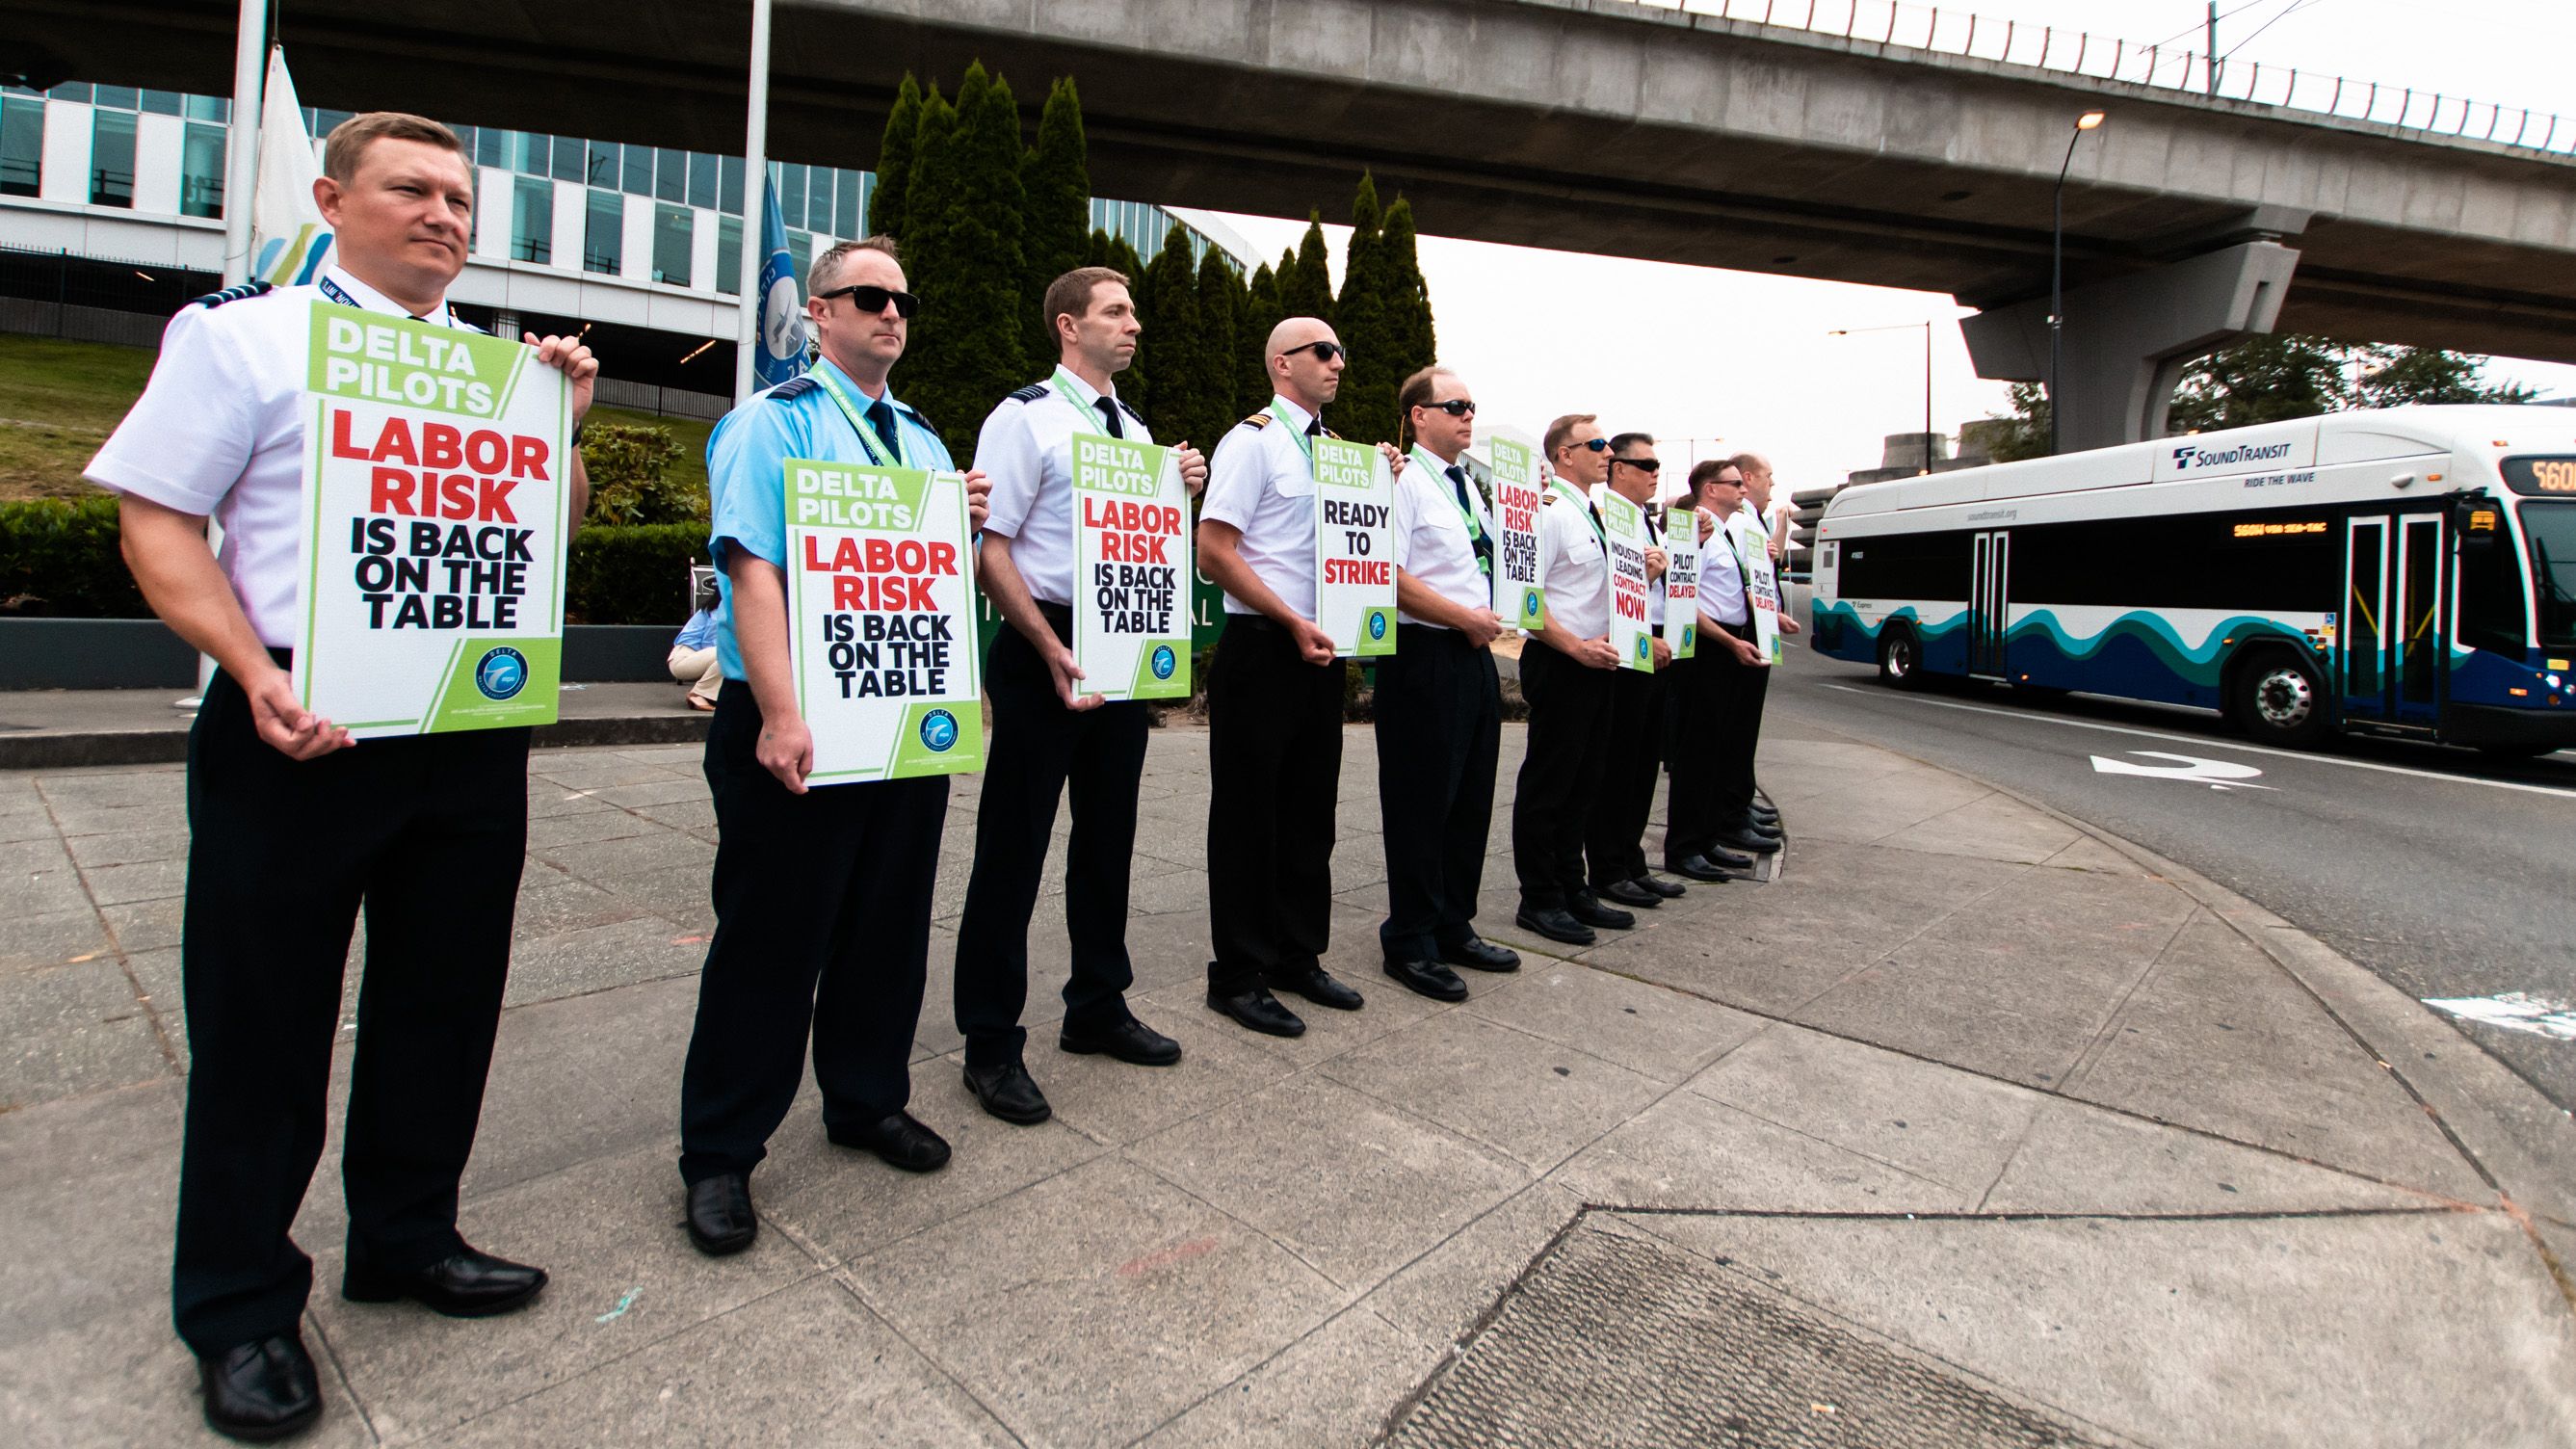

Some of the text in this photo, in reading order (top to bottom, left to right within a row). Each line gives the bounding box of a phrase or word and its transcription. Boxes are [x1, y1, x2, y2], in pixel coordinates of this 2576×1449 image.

[328, 317, 477, 377] DELTA
[326, 357, 493, 414] PILOTS
[332, 408, 550, 482] LABOR
[1080, 440, 1145, 471] DELTA
[1318, 443, 1363, 467] DELTA
[1494, 442, 1523, 465] DELTA
[797, 469, 899, 501] DELTA
[1081, 467, 1154, 495] PILOTS
[1319, 463, 1370, 487] PILOTS
[1495, 461, 1527, 484] PILOTS
[2244, 472, 2315, 487] RIDE THE WAVE
[2532, 461, 2576, 491] 560
[370, 466, 518, 524] RISK
[1497, 483, 1539, 514] LABOR
[798, 498, 913, 529] PILOTS
[1085, 497, 1182, 537] LABOR
[1324, 499, 1390, 529] READY
[1505, 507, 1534, 534] RISK
[1607, 499, 1630, 521] DELTA
[1669, 512, 1688, 526] DELTA
[1967, 509, 2017, 521] soundtransit.org
[1607, 514, 1635, 538] PILOTS
[1669, 525, 1691, 540] PILOTS
[351, 517, 535, 563] IS BACK
[1101, 532, 1168, 565] RISK
[1345, 531, 1371, 556] TO
[1502, 530, 1538, 552] IS BACK
[1611, 540, 1645, 566] INDUSTRY-
[804, 536, 959, 576] LABOR
[1504, 546, 1537, 567] ON THE
[1673, 553, 1695, 570] PILOT
[355, 555, 527, 595] ON THE
[1094, 563, 1114, 587] IS
[1119, 566, 1176, 590] BACK
[1325, 558, 1390, 586] STRIKE
[1505, 564, 1536, 583] TABLE
[1615, 558, 1643, 581] LEADING
[1669, 571, 1696, 584] CONTRACT
[1754, 569, 1770, 587] PILOT
[833, 575, 938, 612] RISK
[1614, 573, 1646, 597] CONTRACT
[1669, 585, 1696, 599] DELAYED
[1754, 584, 1774, 598] CONTRACT
[362, 593, 518, 630] TABLE
[1096, 587, 1173, 612] ON THE
[1616, 592, 1645, 622] NOW
[1754, 595, 1775, 611] DELAYED
[824, 615, 953, 642] IS BACK
[1100, 611, 1170, 634] TABLE
[488, 648, 517, 657] DELTA
[829, 642, 950, 671] ON THE
[835, 670, 947, 699] TABLE
